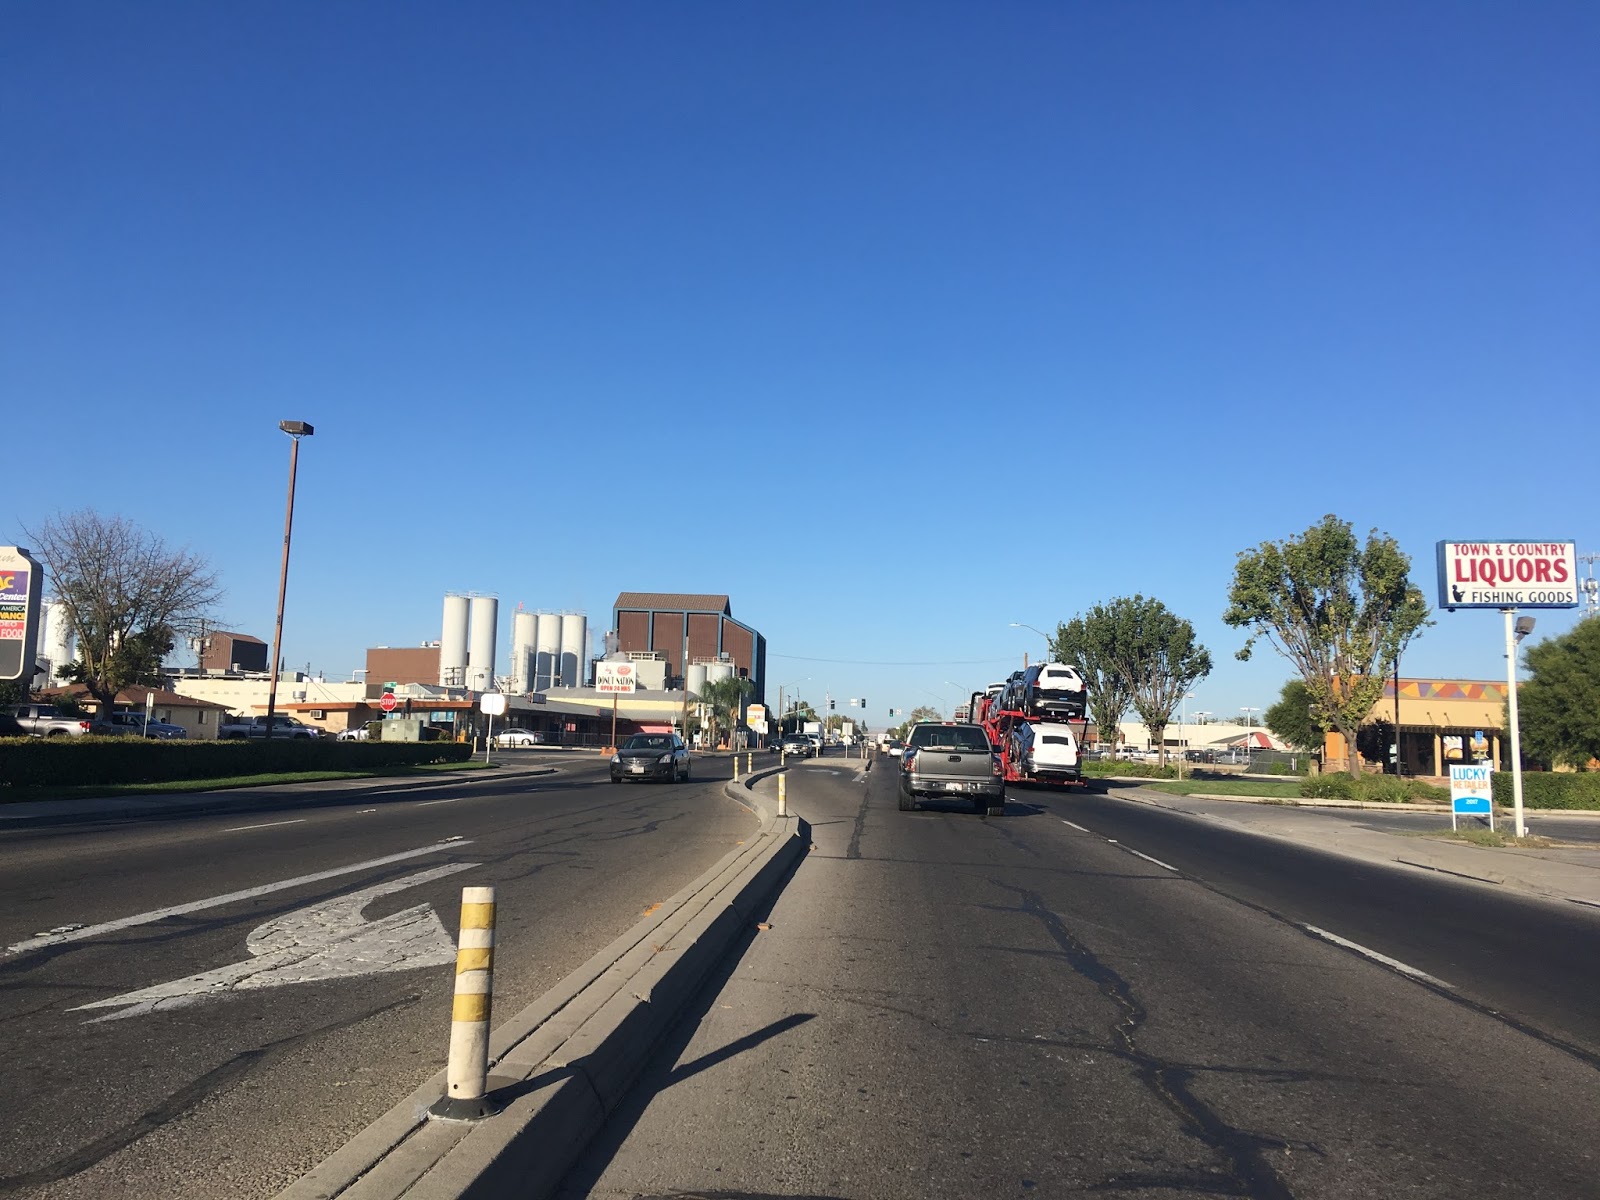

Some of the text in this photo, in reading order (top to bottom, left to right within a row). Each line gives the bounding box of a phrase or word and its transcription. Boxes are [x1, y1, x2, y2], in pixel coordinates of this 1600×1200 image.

[1454, 544, 1566, 556] TOWN & COUNTRY
[1455, 558, 1569, 588] LIQUORS
[1472, 591, 1573, 602] FISHING GOODS
[1, 628, 24, 638] FOOD
[616, 676, 634, 685] NATION
[1453, 768, 1486, 780] LUCKY
[1454, 780, 1488, 790] RETAILER
